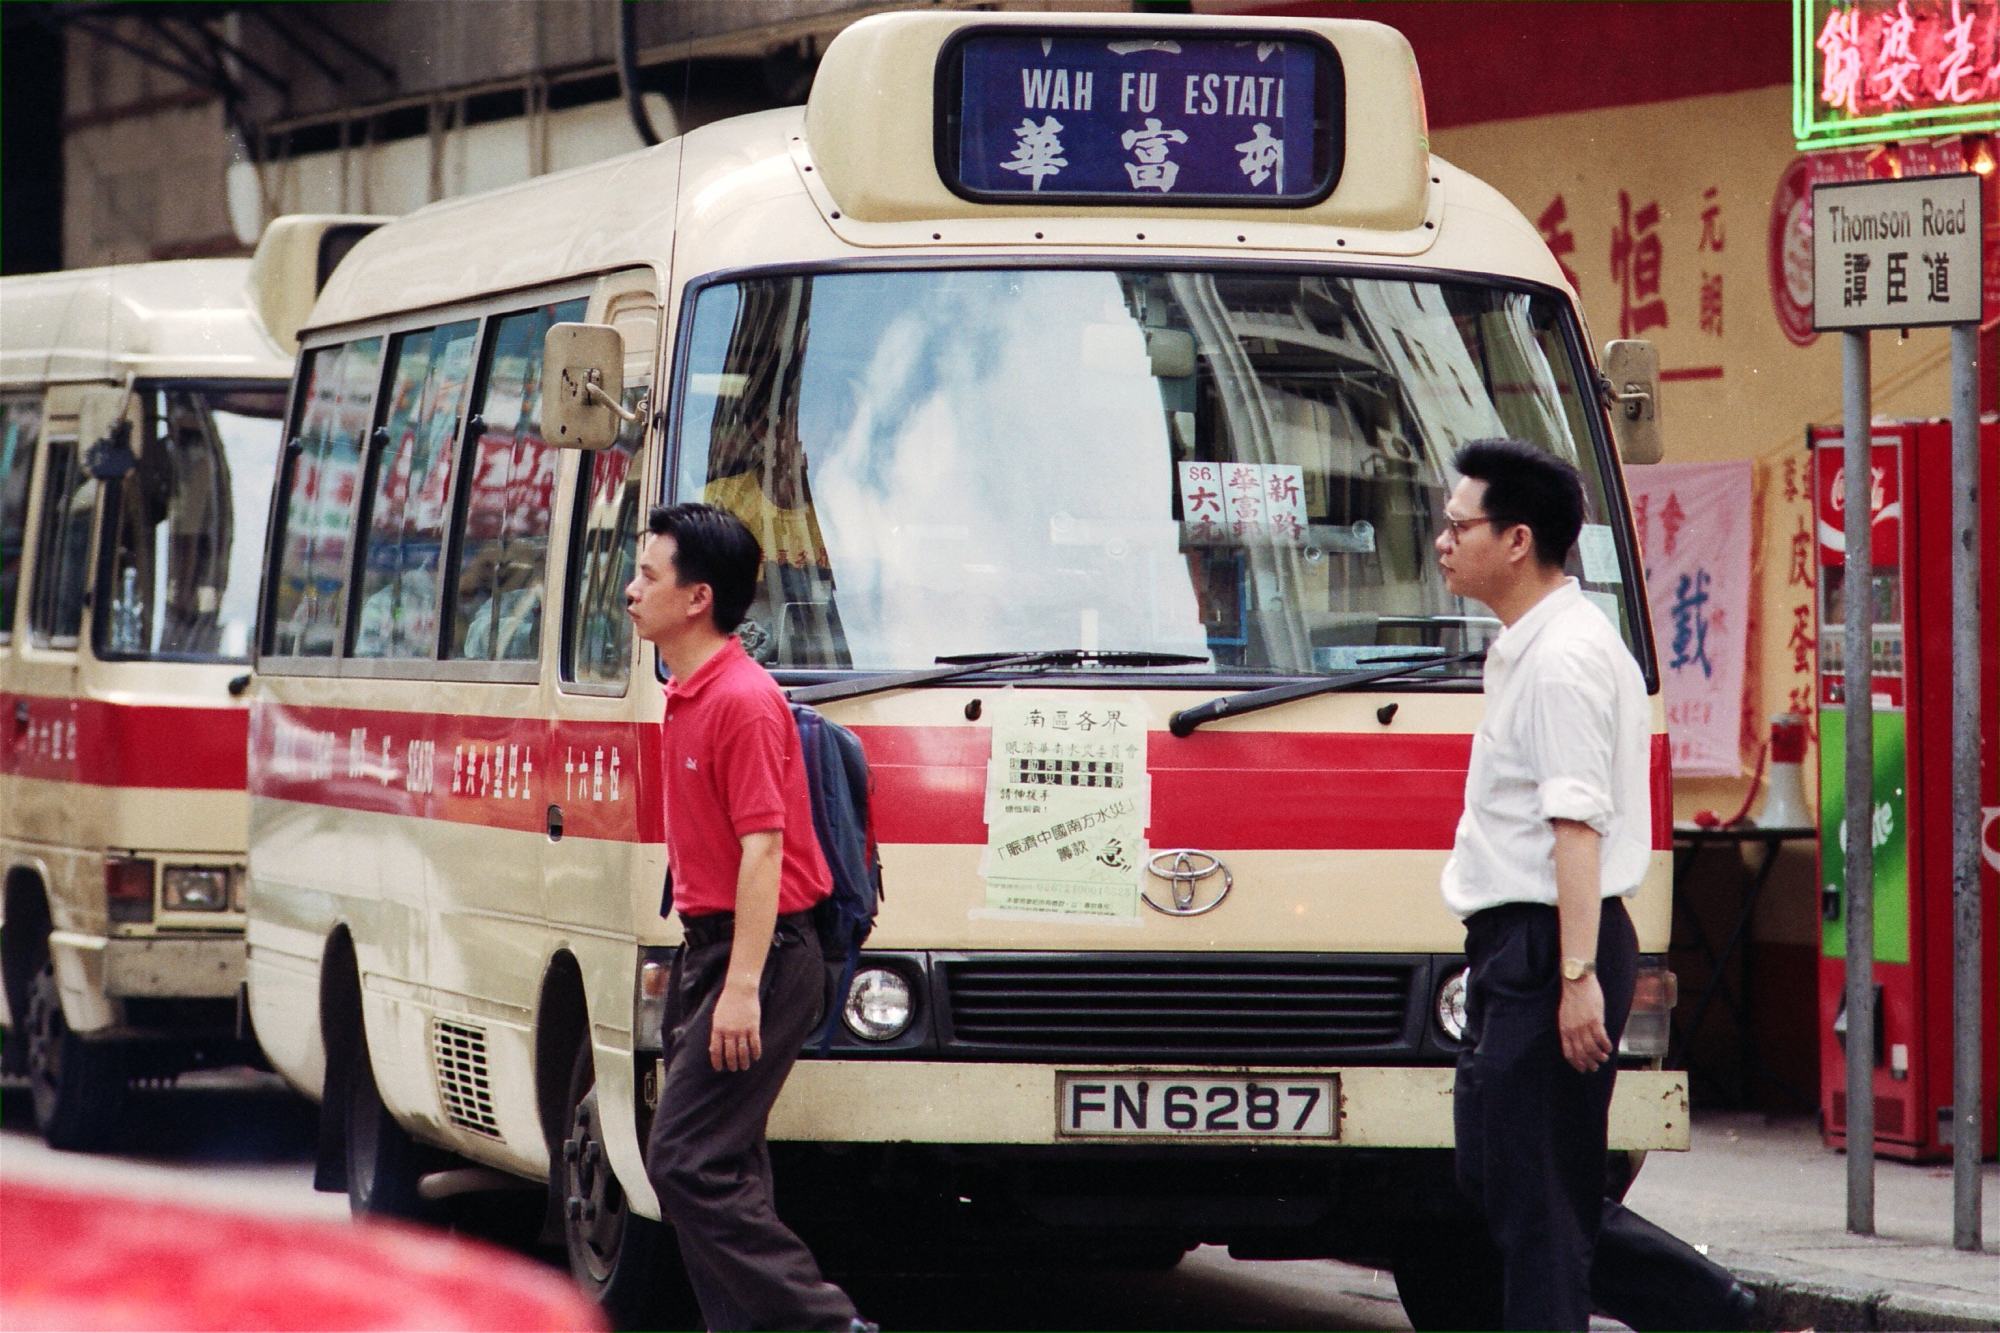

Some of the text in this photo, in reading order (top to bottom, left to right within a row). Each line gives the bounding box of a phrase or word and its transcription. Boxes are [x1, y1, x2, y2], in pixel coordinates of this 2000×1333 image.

[1022, 68, 1093, 111] WAH
[1120, 73, 1158, 113] FU
[1829, 198, 1967, 243] Thomson Road
[1843, 251, 1951, 308] 譚臣道
[1024, 709, 1128, 734] 南區各界
[564, 746, 620, 802] 十六座位
